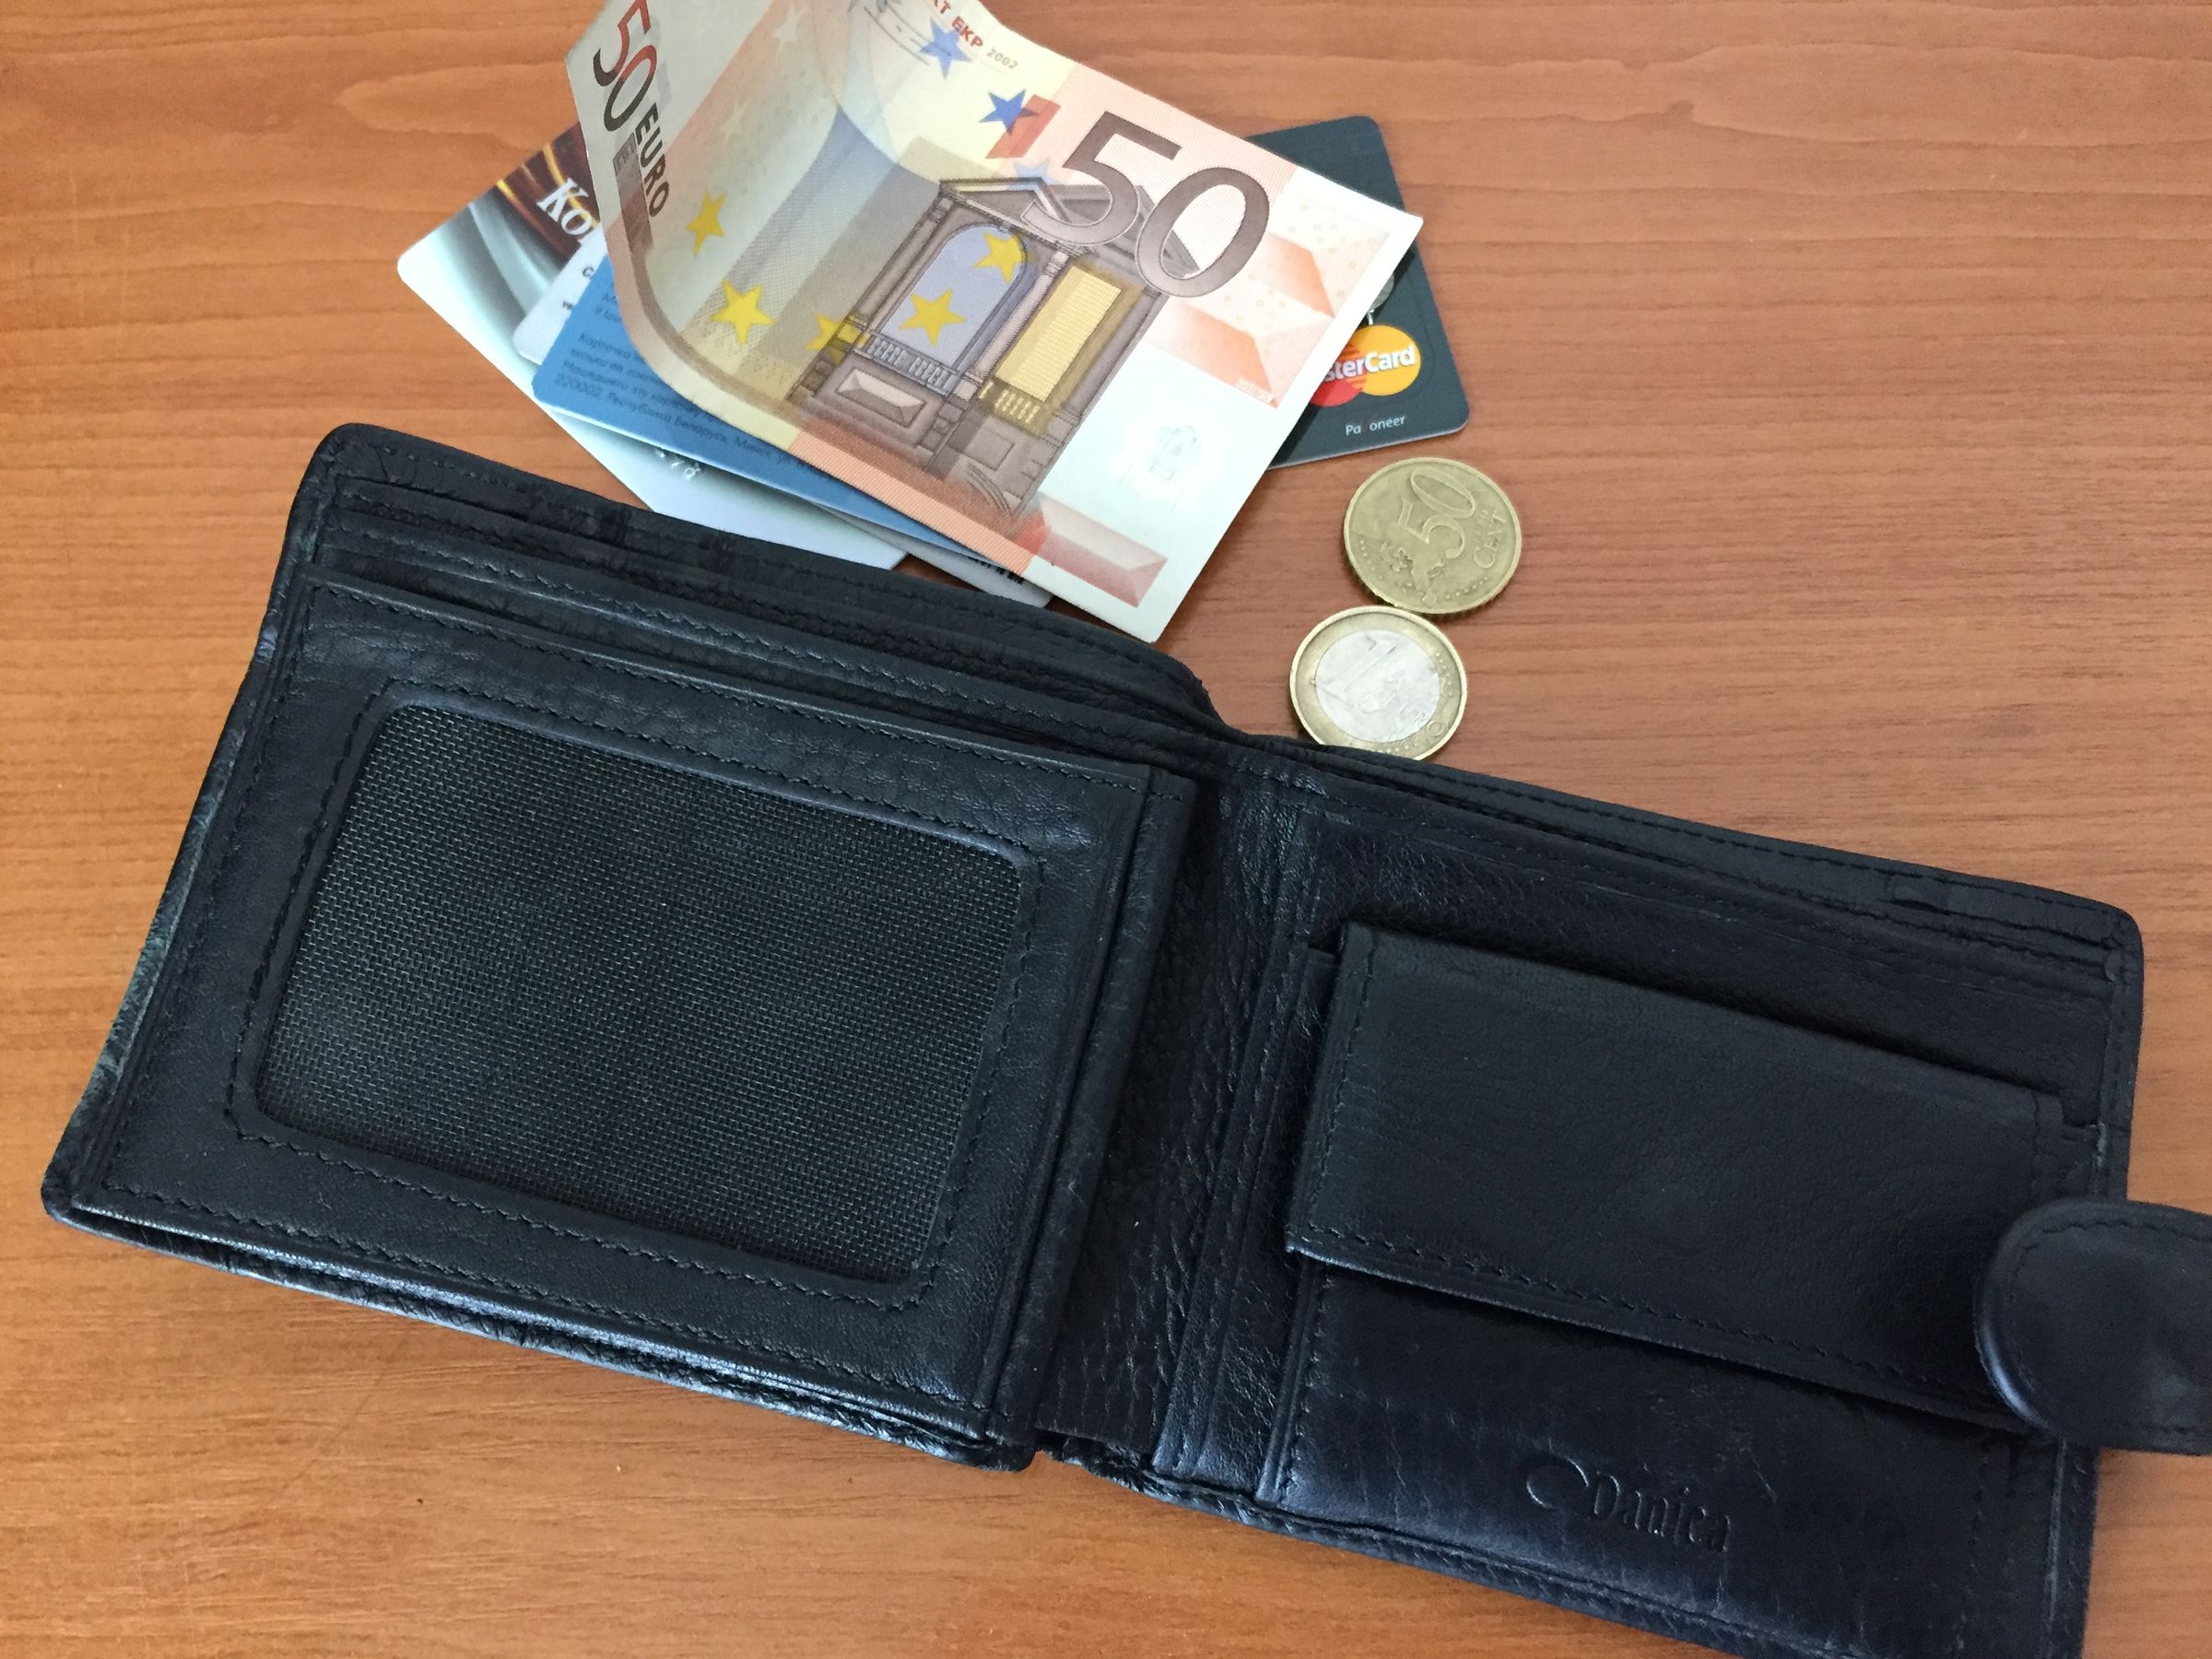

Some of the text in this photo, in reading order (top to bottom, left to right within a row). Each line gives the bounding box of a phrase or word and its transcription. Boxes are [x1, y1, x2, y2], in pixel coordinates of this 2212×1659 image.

[593, 0, 657, 132] 50
[951, 16, 984, 47] EKP
[987, 48, 1019, 70] 2002
[635, 101, 670, 218] EURO
[1019, 110, 1270, 298] 50
[1345, 415, 1406, 437] Paoneer
